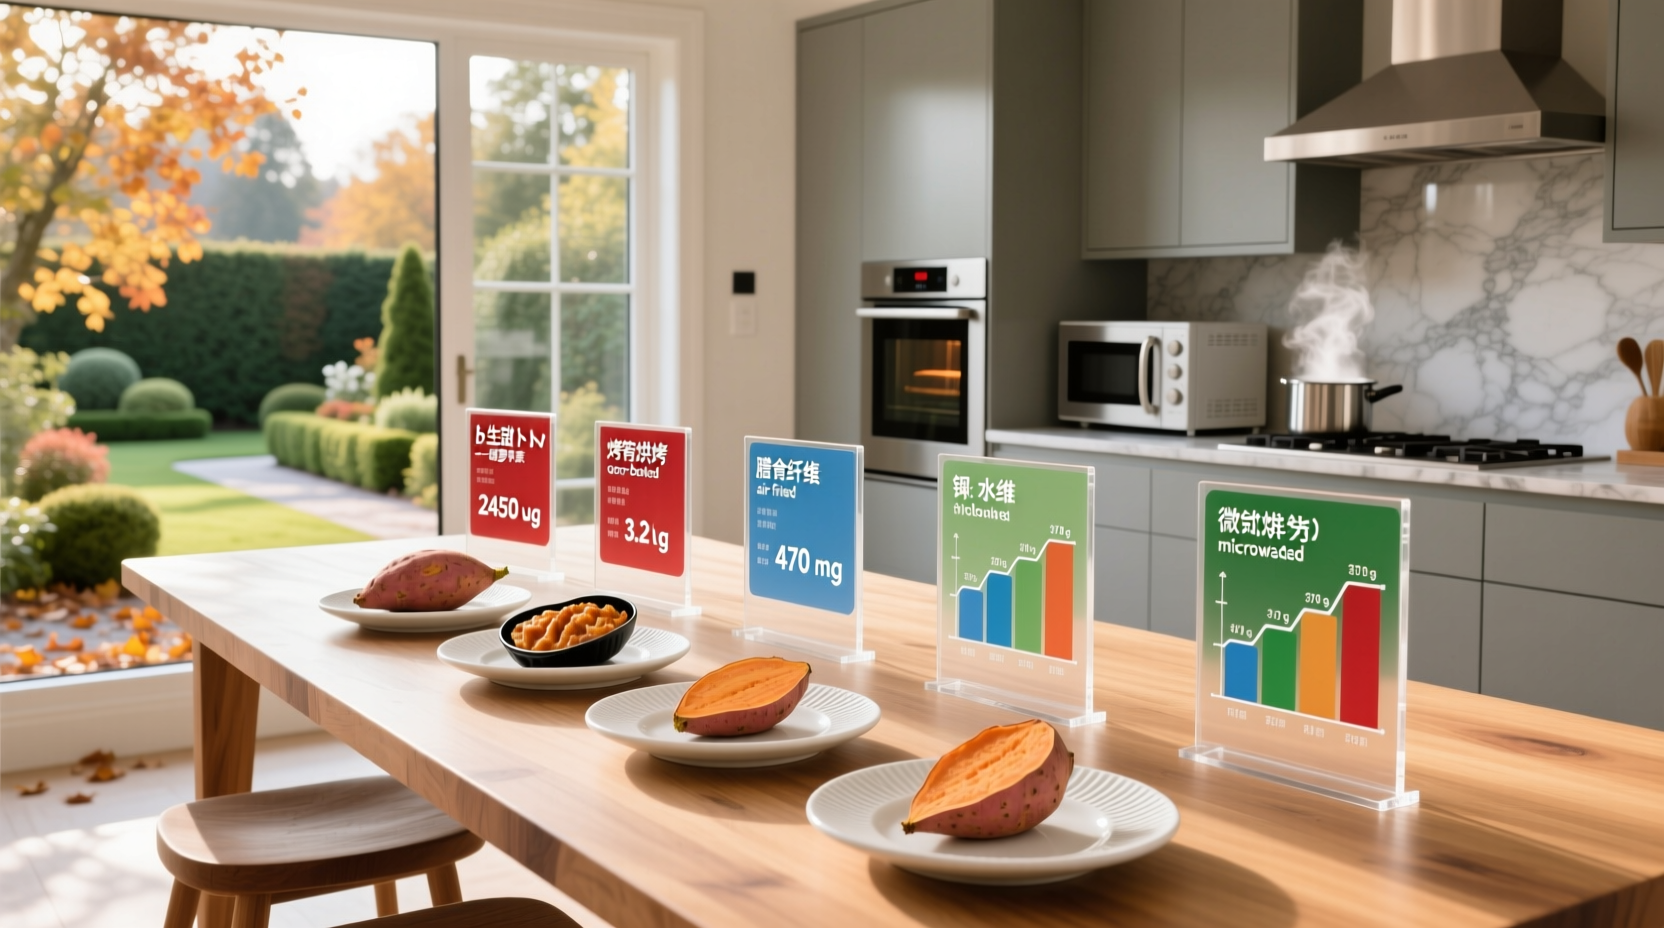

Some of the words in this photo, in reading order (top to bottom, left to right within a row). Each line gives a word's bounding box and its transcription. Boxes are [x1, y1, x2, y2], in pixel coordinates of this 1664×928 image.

[478, 493, 519, 520] 2450
[521, 506, 541, 529] ug
[774, 544, 811, 574] 470
[814, 558, 843, 587] mg
